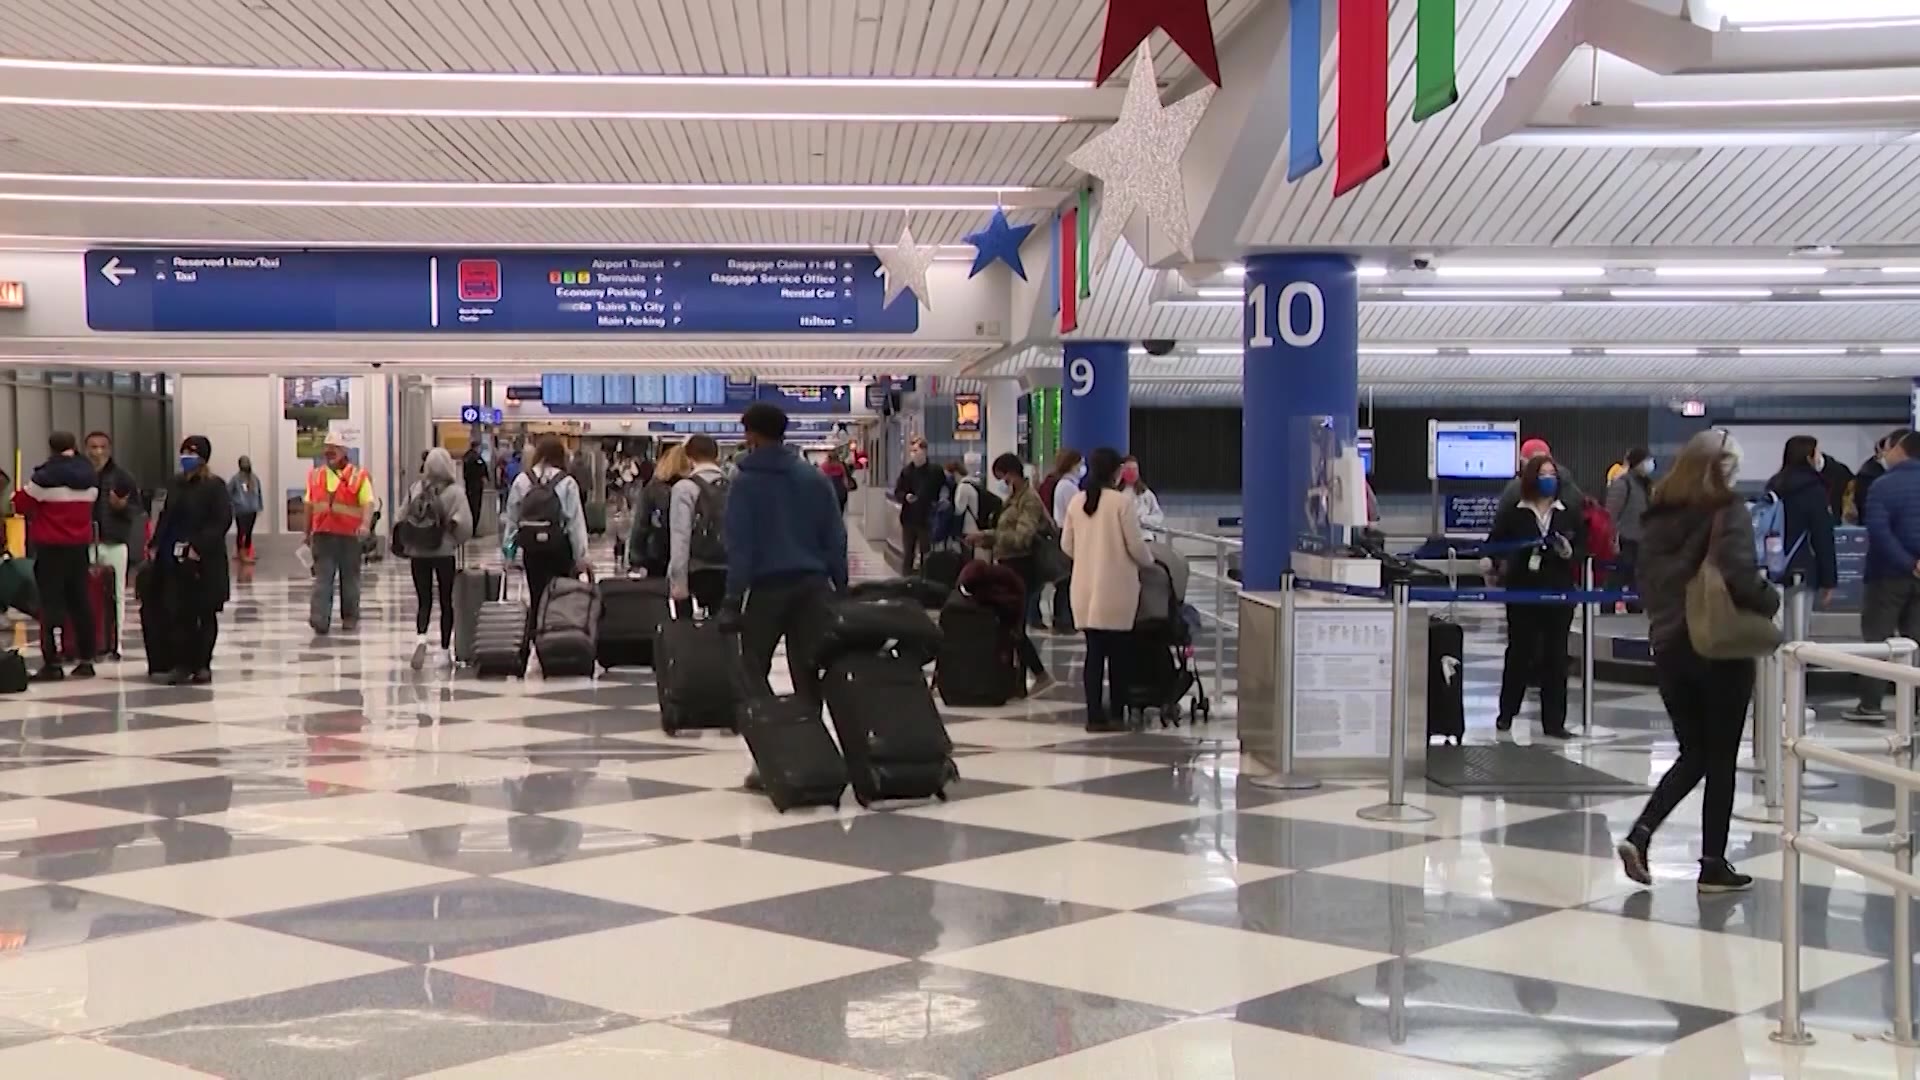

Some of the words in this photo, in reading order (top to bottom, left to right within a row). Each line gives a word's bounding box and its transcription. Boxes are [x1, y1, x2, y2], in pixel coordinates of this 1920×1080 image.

[173, 257, 225, 267] Reserved
[226, 257, 280, 269] Limo/Taxi
[592, 259, 627, 270] Airport
[629, 259, 664, 268] Transit
[728, 259, 774, 271] Baggage
[776, 259, 806, 269] Claim
[174, 271, 197, 282] Taxi
[597, 274, 646, 283] Terminals
[711, 273, 758, 285] Baggage
[760, 273, 801, 284] Service
[802, 273, 836, 284] Office
[556, 287, 605, 298] Economy
[607, 287, 648, 298] Parking
[781, 289, 815, 298] Rental
[816, 289, 836, 299] Car
[596, 301, 627, 312] Trains
[629, 302, 642, 312] To
[644, 302, 665, 314] City
[800, 315, 836, 326] Hilton
[1246, 281, 1325, 348] 10
[598, 316, 624, 326] Main
[626, 316, 665, 328] Parking
[1070, 358, 1095, 397] 9
